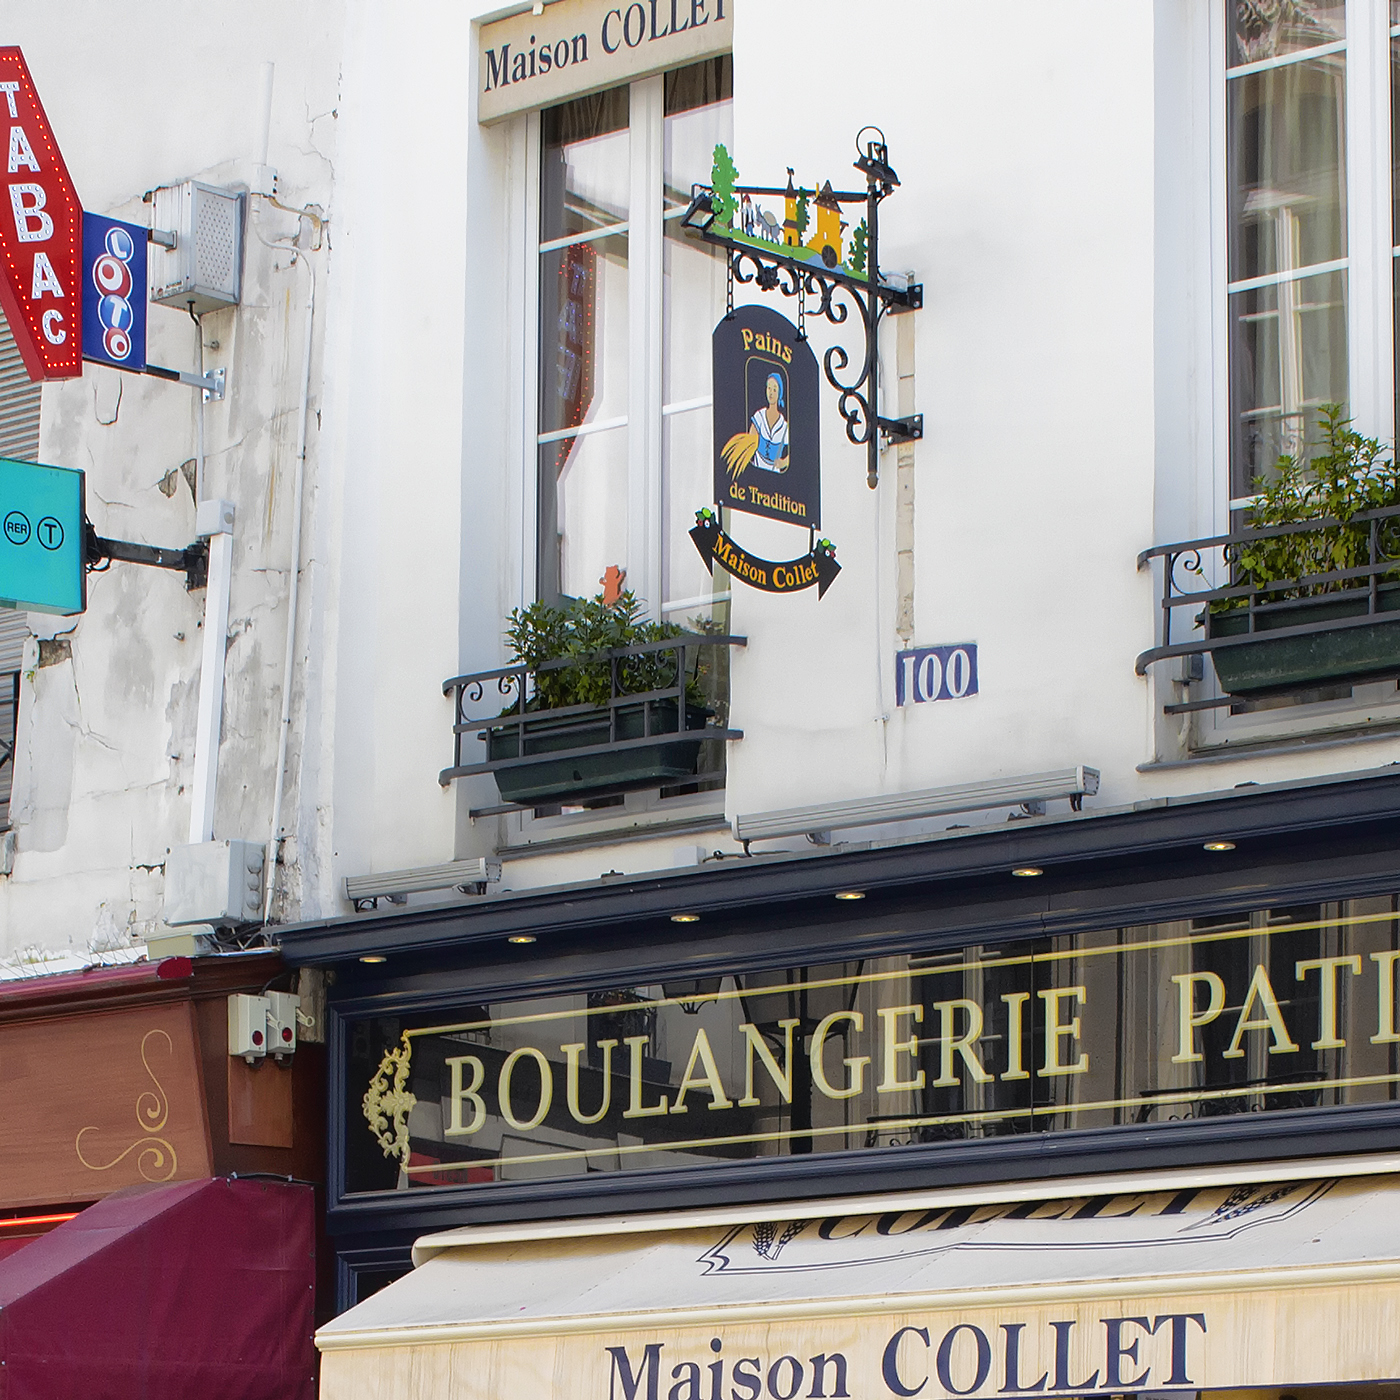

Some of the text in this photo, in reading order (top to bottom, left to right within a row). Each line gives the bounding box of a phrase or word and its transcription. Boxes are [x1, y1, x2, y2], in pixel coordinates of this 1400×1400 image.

[484, 33, 589, 93] Maison
[96, 230, 132, 358] LOTO
[741, 328, 793, 364] Pains
[729, 482, 807, 516] de Tradition
[6, 519, 28, 534] RER
[44, 523, 57, 544] T
[712, 534, 819, 589] Maison Collet
[903, 649, 970, 706] 100
[444, 985, 1090, 1138] BOULANGERIE
[881, 1312, 1208, 1398] COLLET
